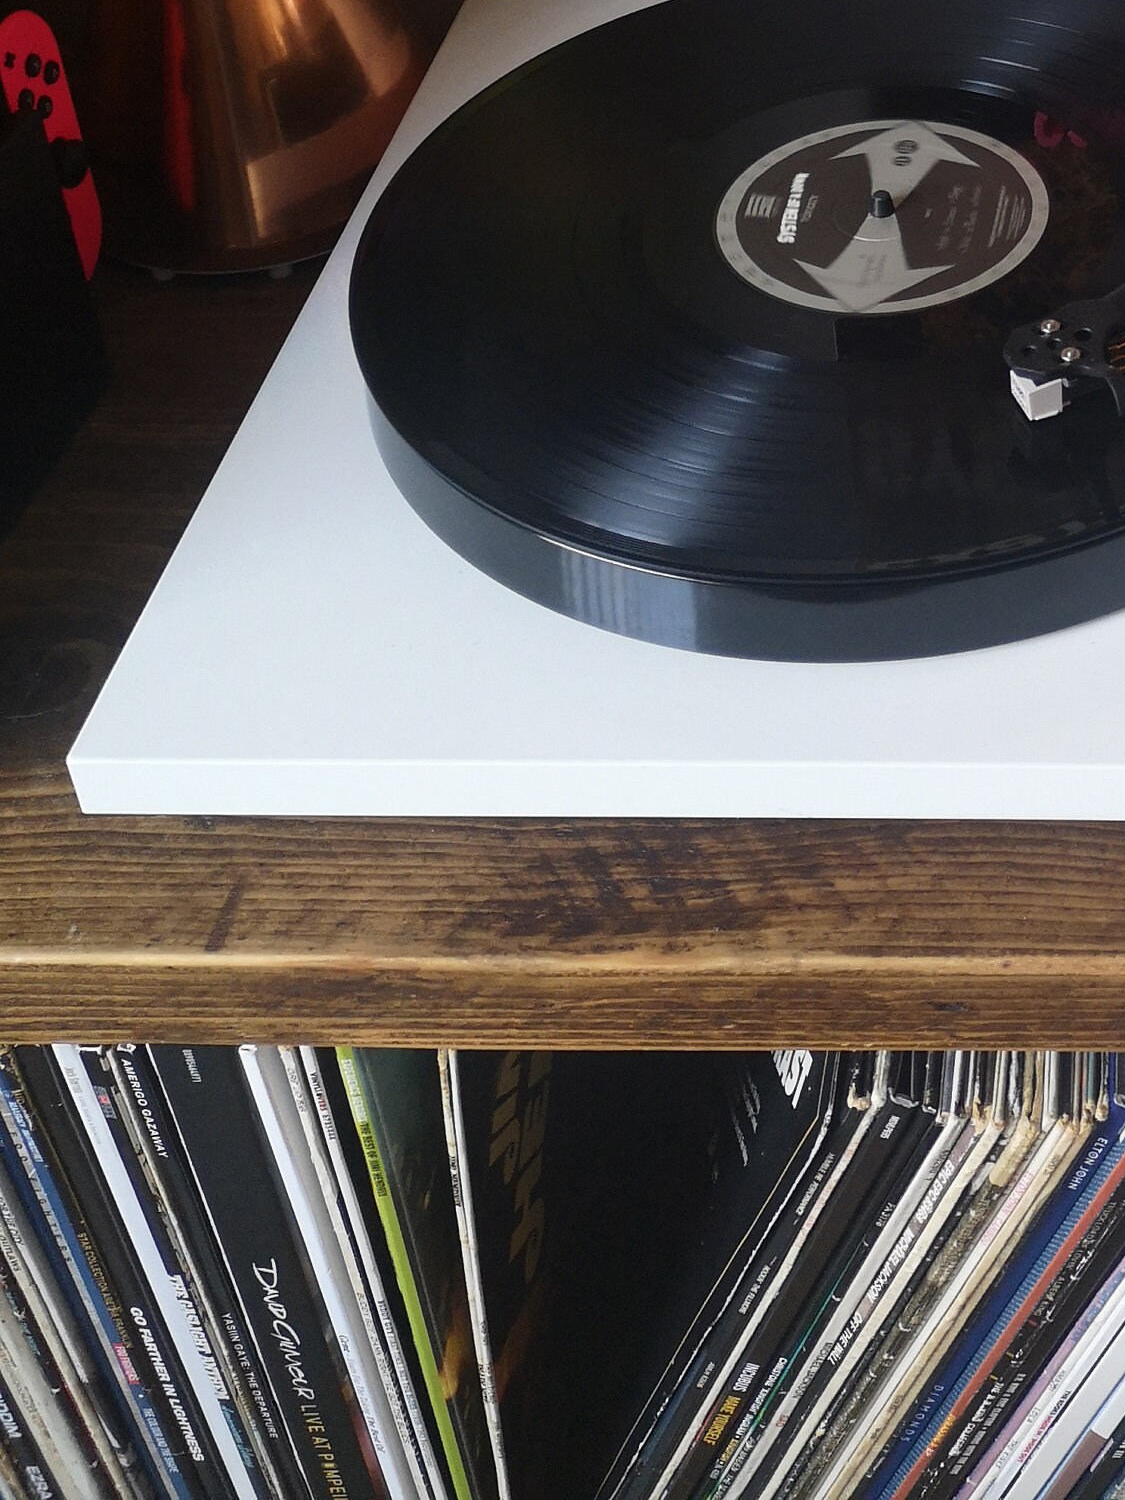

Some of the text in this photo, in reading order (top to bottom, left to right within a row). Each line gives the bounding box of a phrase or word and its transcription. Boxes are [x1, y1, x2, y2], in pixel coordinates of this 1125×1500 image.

[119, 1056, 169, 1160] AMERIGO GAZAWAY
[359, 1122, 371, 1135] THE
[362, 1134, 375, 1150] BEST
[366, 1149, 377, 1160] OF
[1066, 1135, 1108, 1193] ELTON JOHN
[825, 1158, 957, 1367] EPIC EPC MICHAEL JACKSON OFF THE WALL
[168, 1272, 189, 1301] THE
[221, 1311, 241, 1343] YASIIN
[129, 1304, 205, 1464] GO FARTHER IN LIGHTNESS
[244, 1370, 260, 1390] THE
[732, 1359, 760, 1395] INCUBUS
[251, 1387, 279, 1441] DEPARTURE
[300, 1401, 325, 1436] LIVE
[719, 1392, 741, 1417] MAKE
[898, 1382, 944, 1445] DIAMONDS
[311, 1432, 331, 1452] AT
[702, 1410, 731, 1447] YOURSELF
[1110, 1446, 1125, 1462] III
